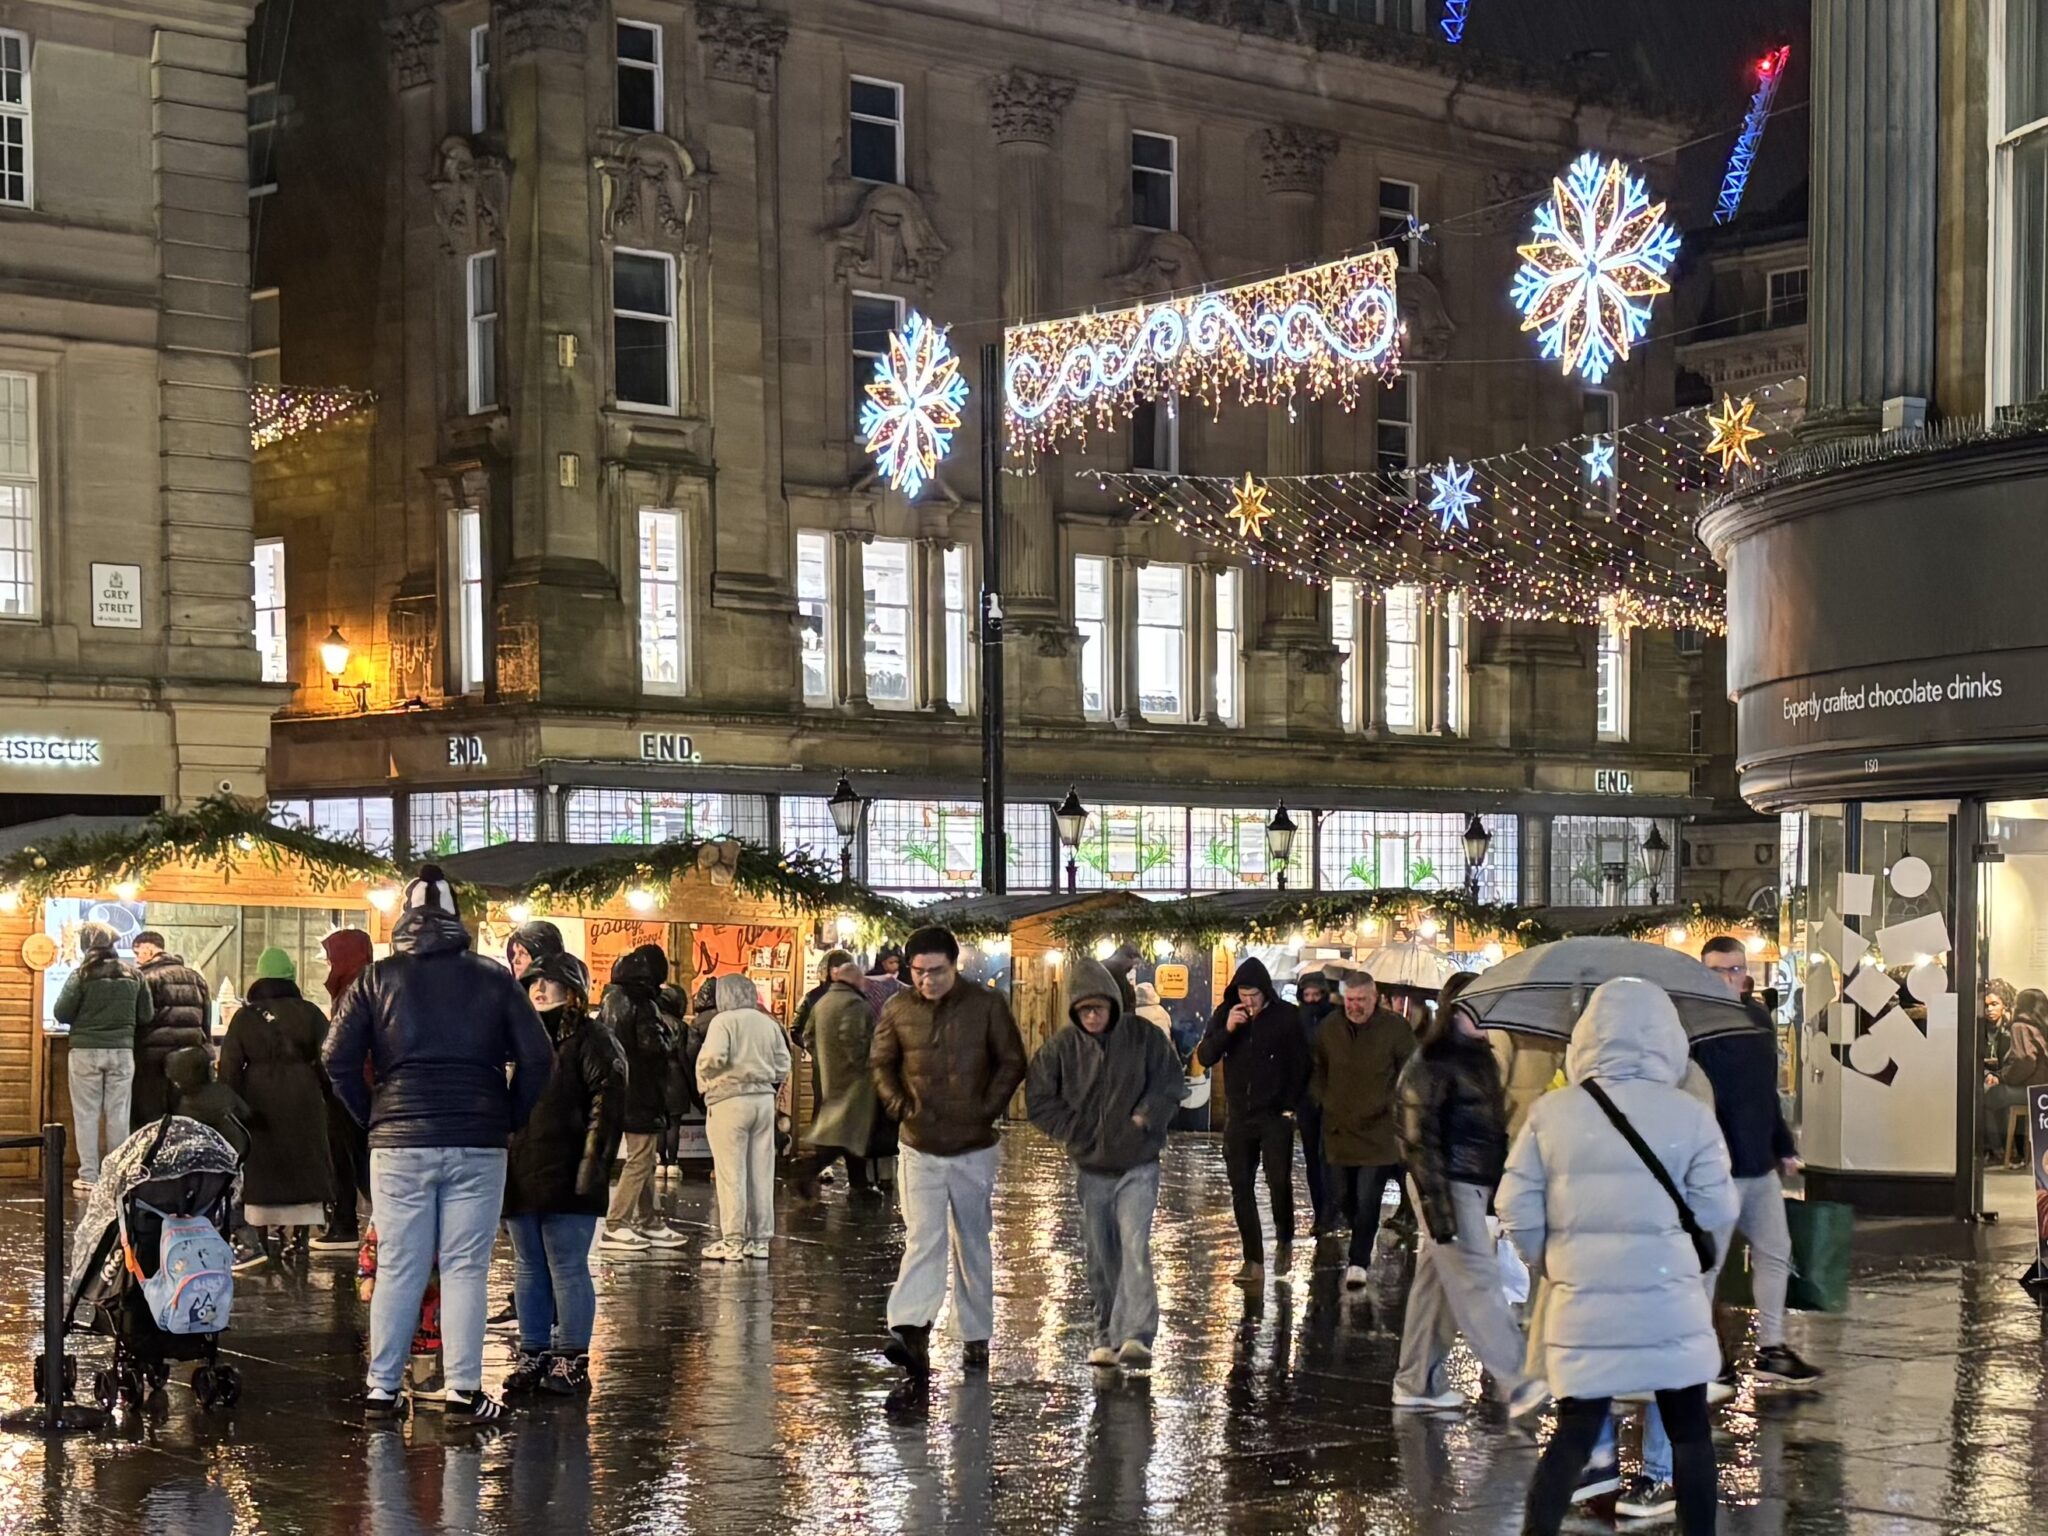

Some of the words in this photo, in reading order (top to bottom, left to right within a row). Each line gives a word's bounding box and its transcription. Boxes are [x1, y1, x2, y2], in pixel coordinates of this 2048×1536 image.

[103, 589, 129, 600] GREY
[98, 602, 134, 614] STREET
[1782, 691, 1822, 727] Expertly
[1822, 684, 1865, 714] crafted
[1867, 678, 1943, 708] chocolate
[1946, 671, 2003, 700] drinks
[639, 731, 703, 764] END.
[1863, 758, 1880, 774] 150
[1594, 768, 1634, 794] END.
